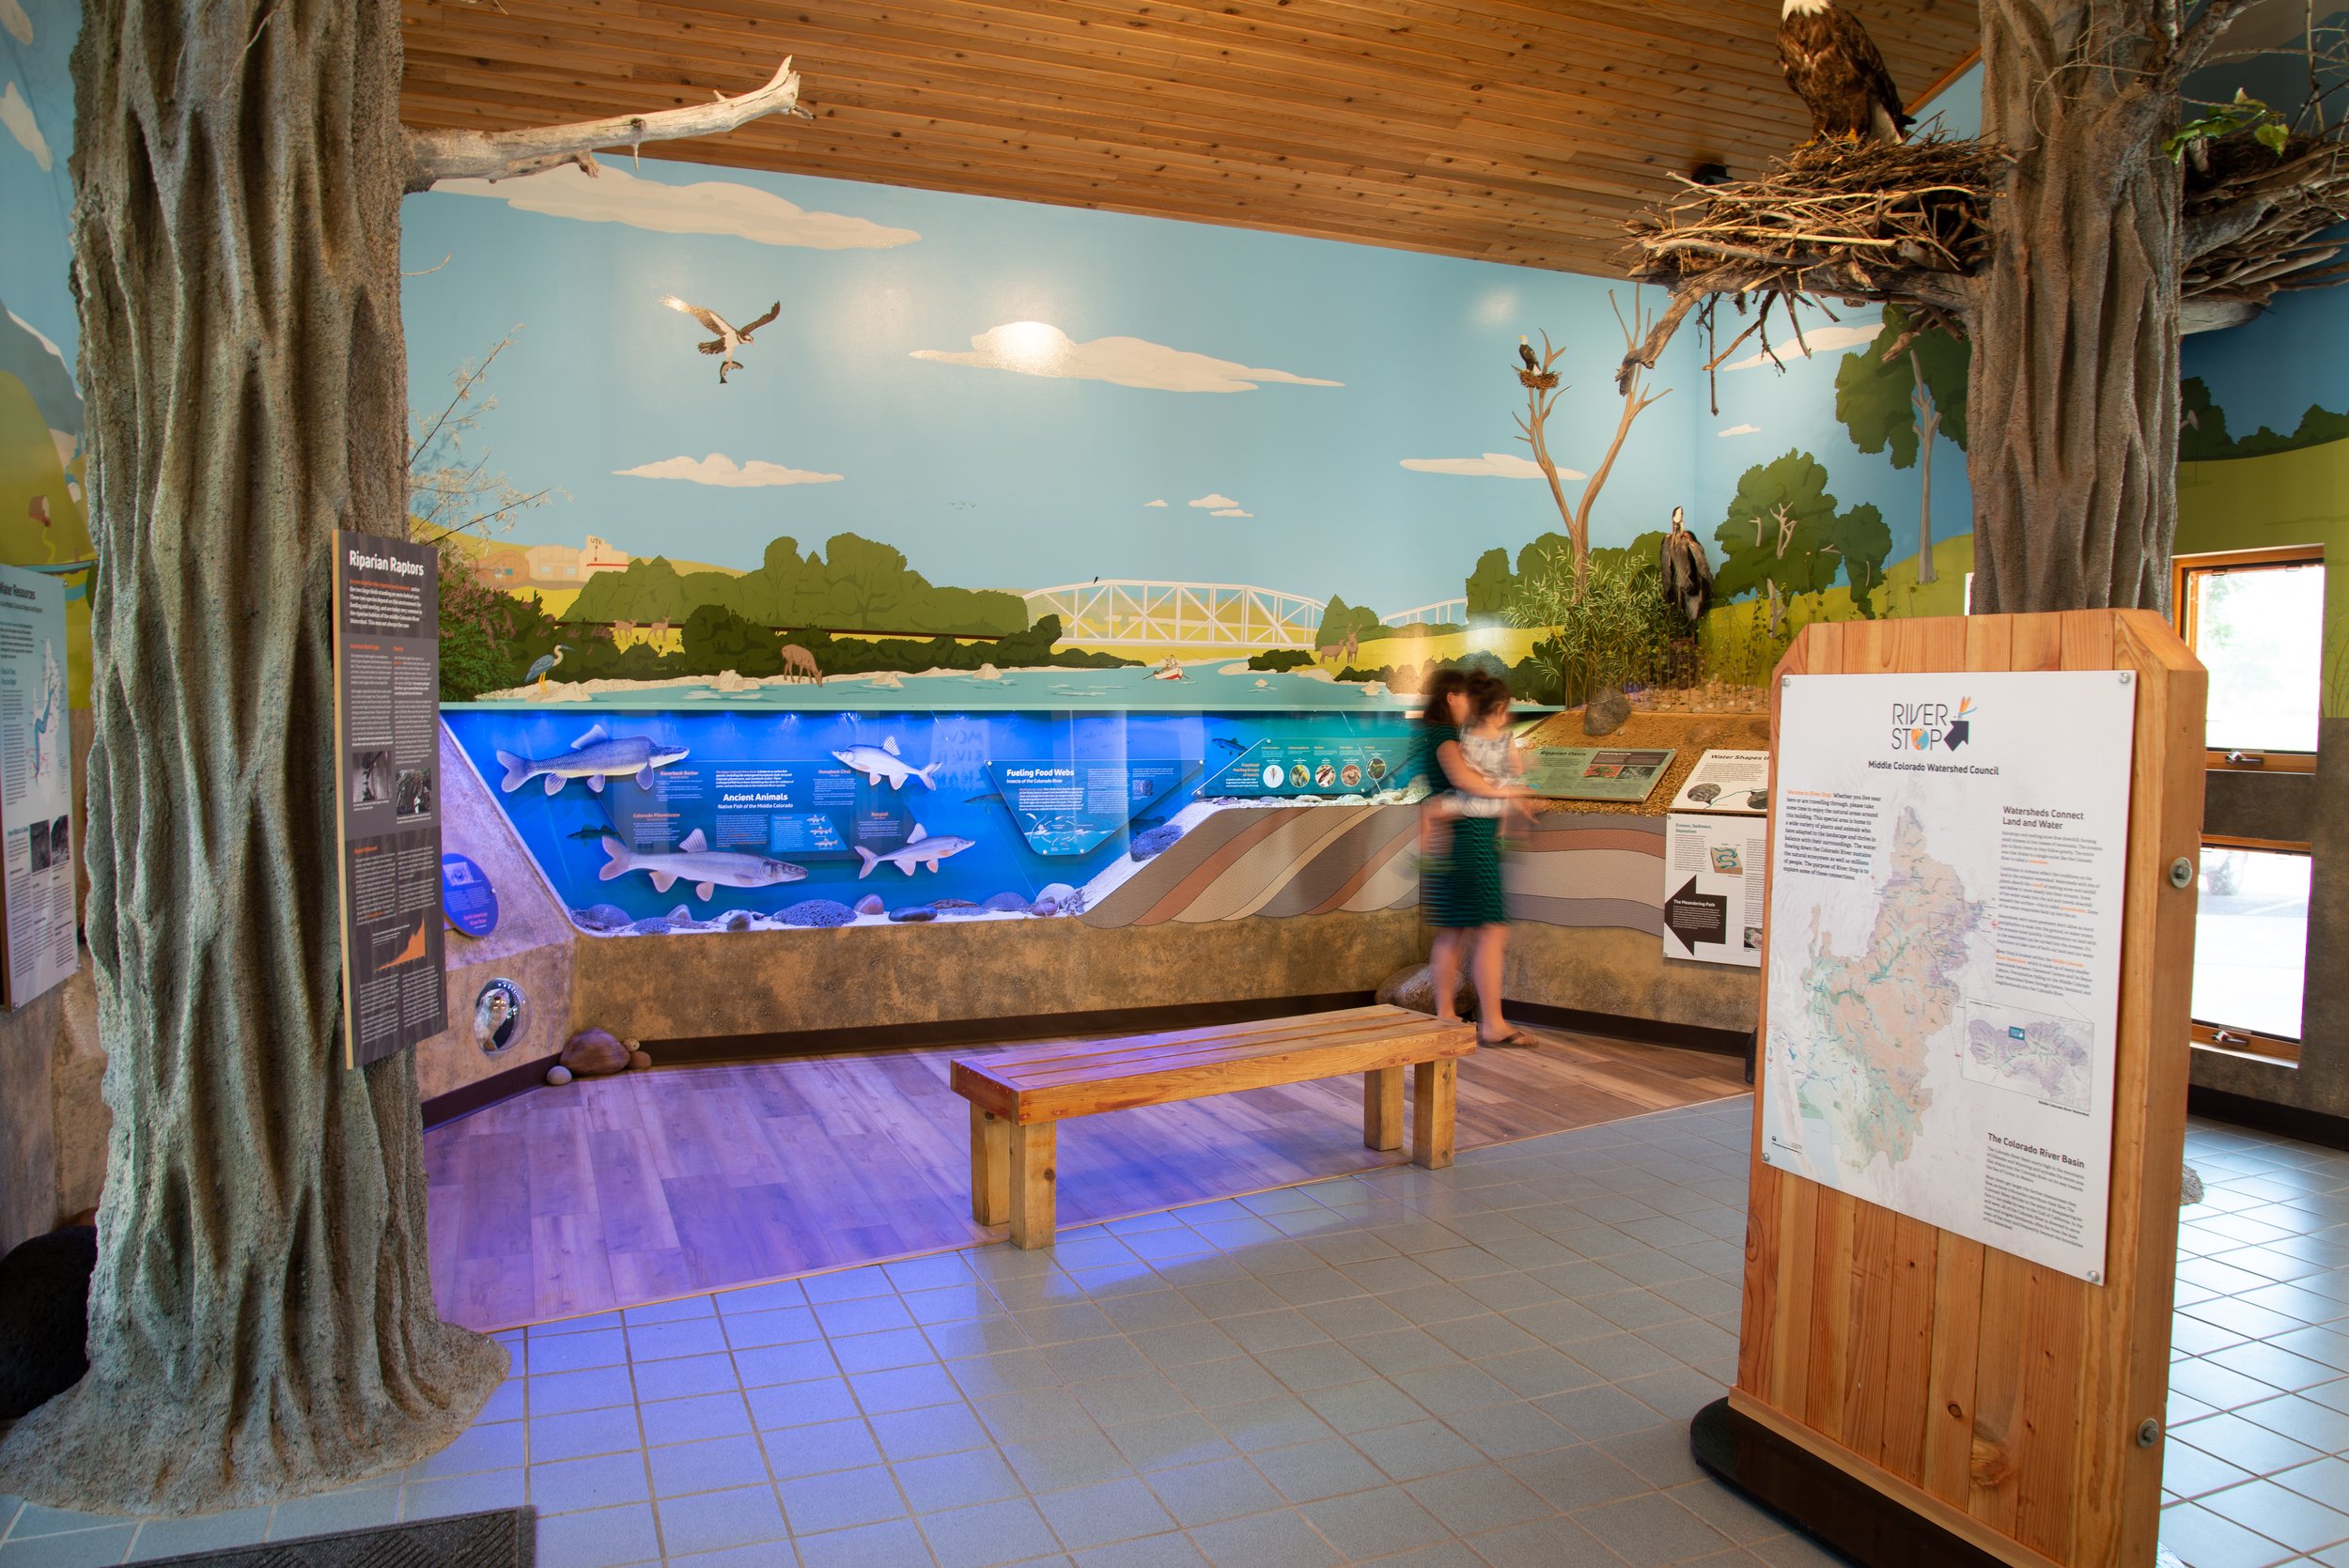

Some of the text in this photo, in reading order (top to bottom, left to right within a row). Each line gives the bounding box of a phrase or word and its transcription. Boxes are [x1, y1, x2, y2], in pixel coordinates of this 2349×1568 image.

[349, 550, 424, 577] Riparian Raptors
[1892, 703, 1948, 726] RIVER
[1891, 728, 1943, 751] STOP
[1007, 769, 1034, 778] Fueling
[1868, 760, 1999, 775] Middle Colorado Watershed Council
[723, 793, 788, 801] Ancient Animals
[2003, 806, 2084, 820] Watersheds Connect
[2003, 817, 2063, 829] Land and Water
[1988, 1132, 2085, 1168] The Colorado River Basin
